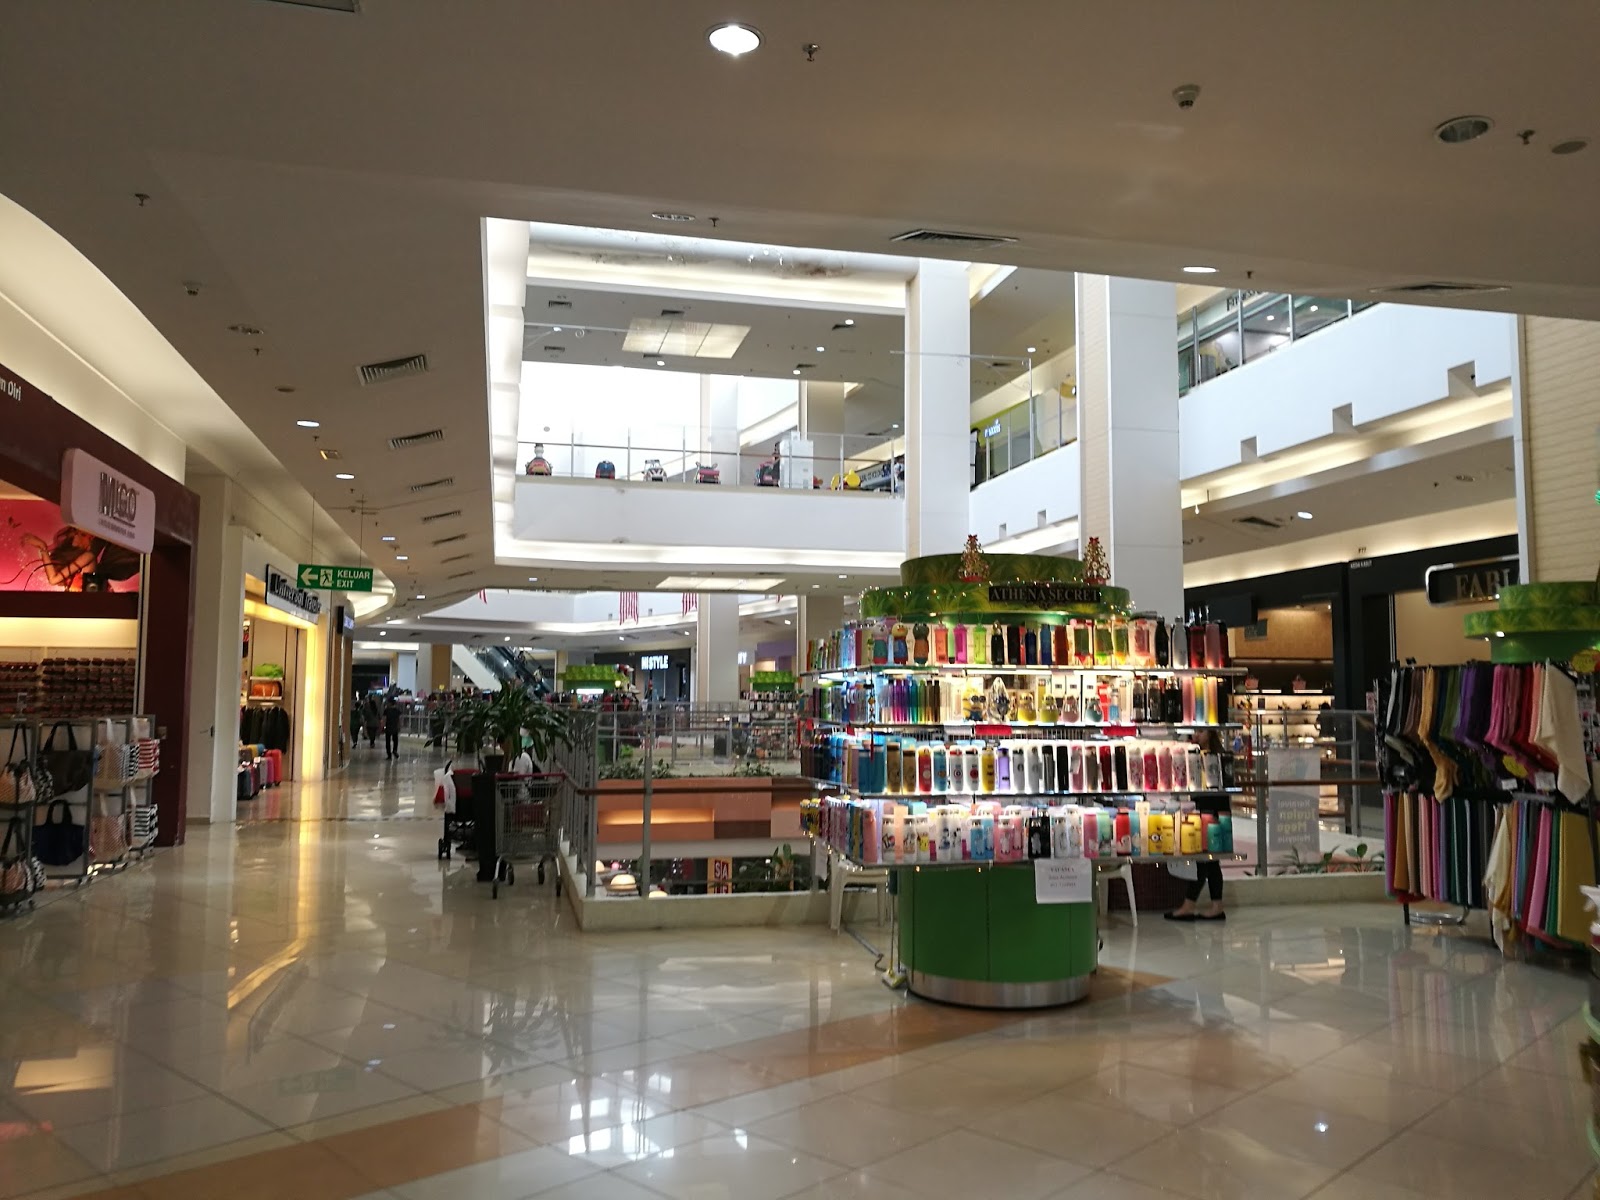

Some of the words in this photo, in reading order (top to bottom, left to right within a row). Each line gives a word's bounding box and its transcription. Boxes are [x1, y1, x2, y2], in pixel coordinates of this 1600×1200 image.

[7, 380, 22, 401] Diri
[336, 569, 371, 580] KELUAR
[336, 579, 354, 589] EXIT
[1456, 568, 1520, 599] FABI
[991, 587, 1046, 601] ATHENA
[1049, 587, 1099, 601] SECRET
